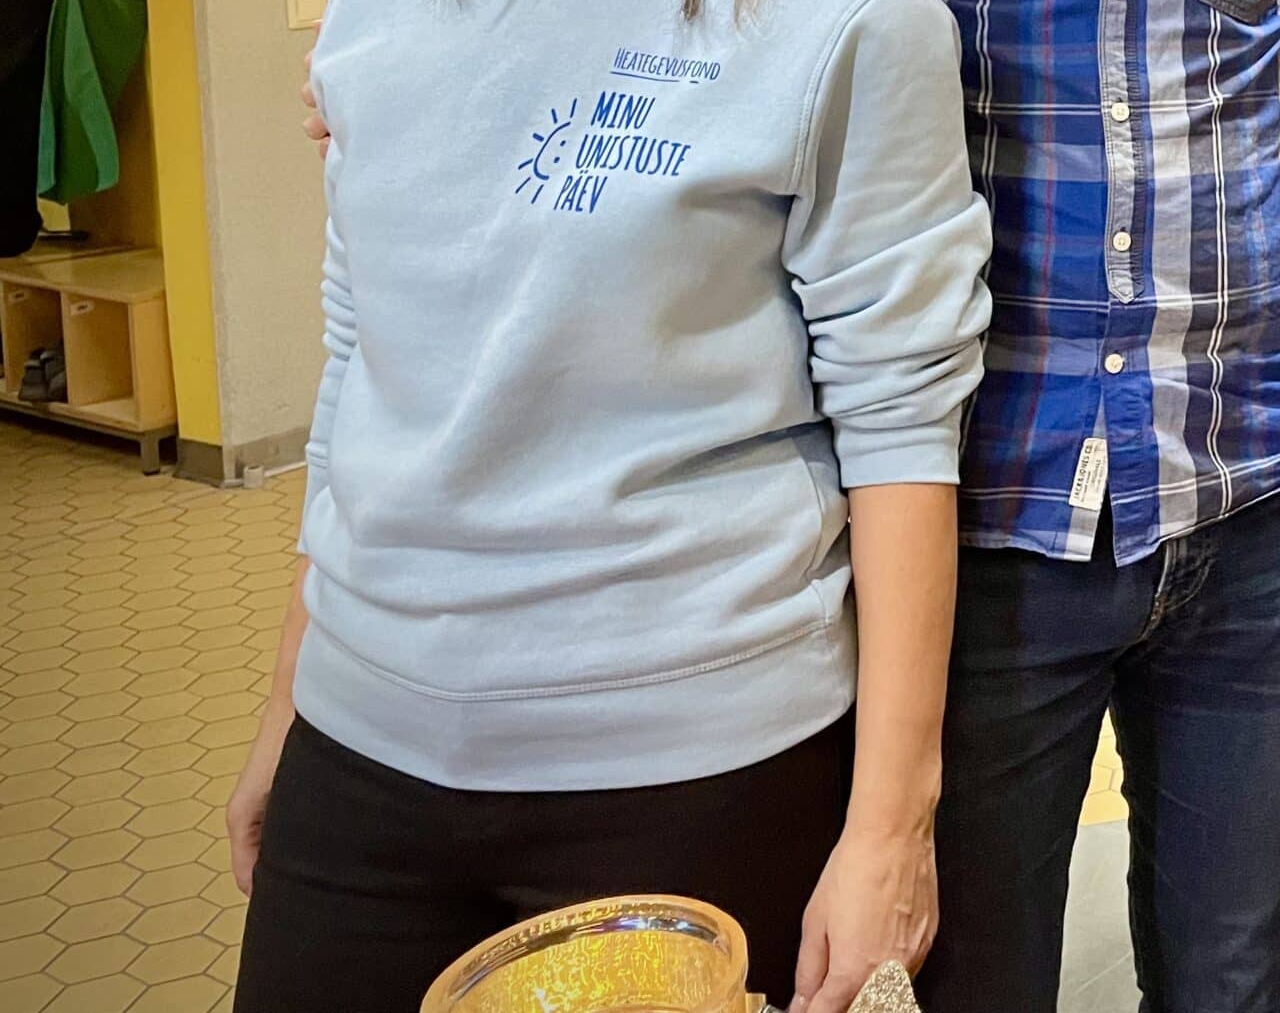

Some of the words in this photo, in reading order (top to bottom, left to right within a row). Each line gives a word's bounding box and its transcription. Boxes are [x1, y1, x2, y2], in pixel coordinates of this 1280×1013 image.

[613, 47, 721, 80] HEATEGEVUSFOND
[590, 90, 656, 130] MINU
[575, 134, 691, 176] UNISTUSTE
[553, 169, 608, 214] PÄEV
